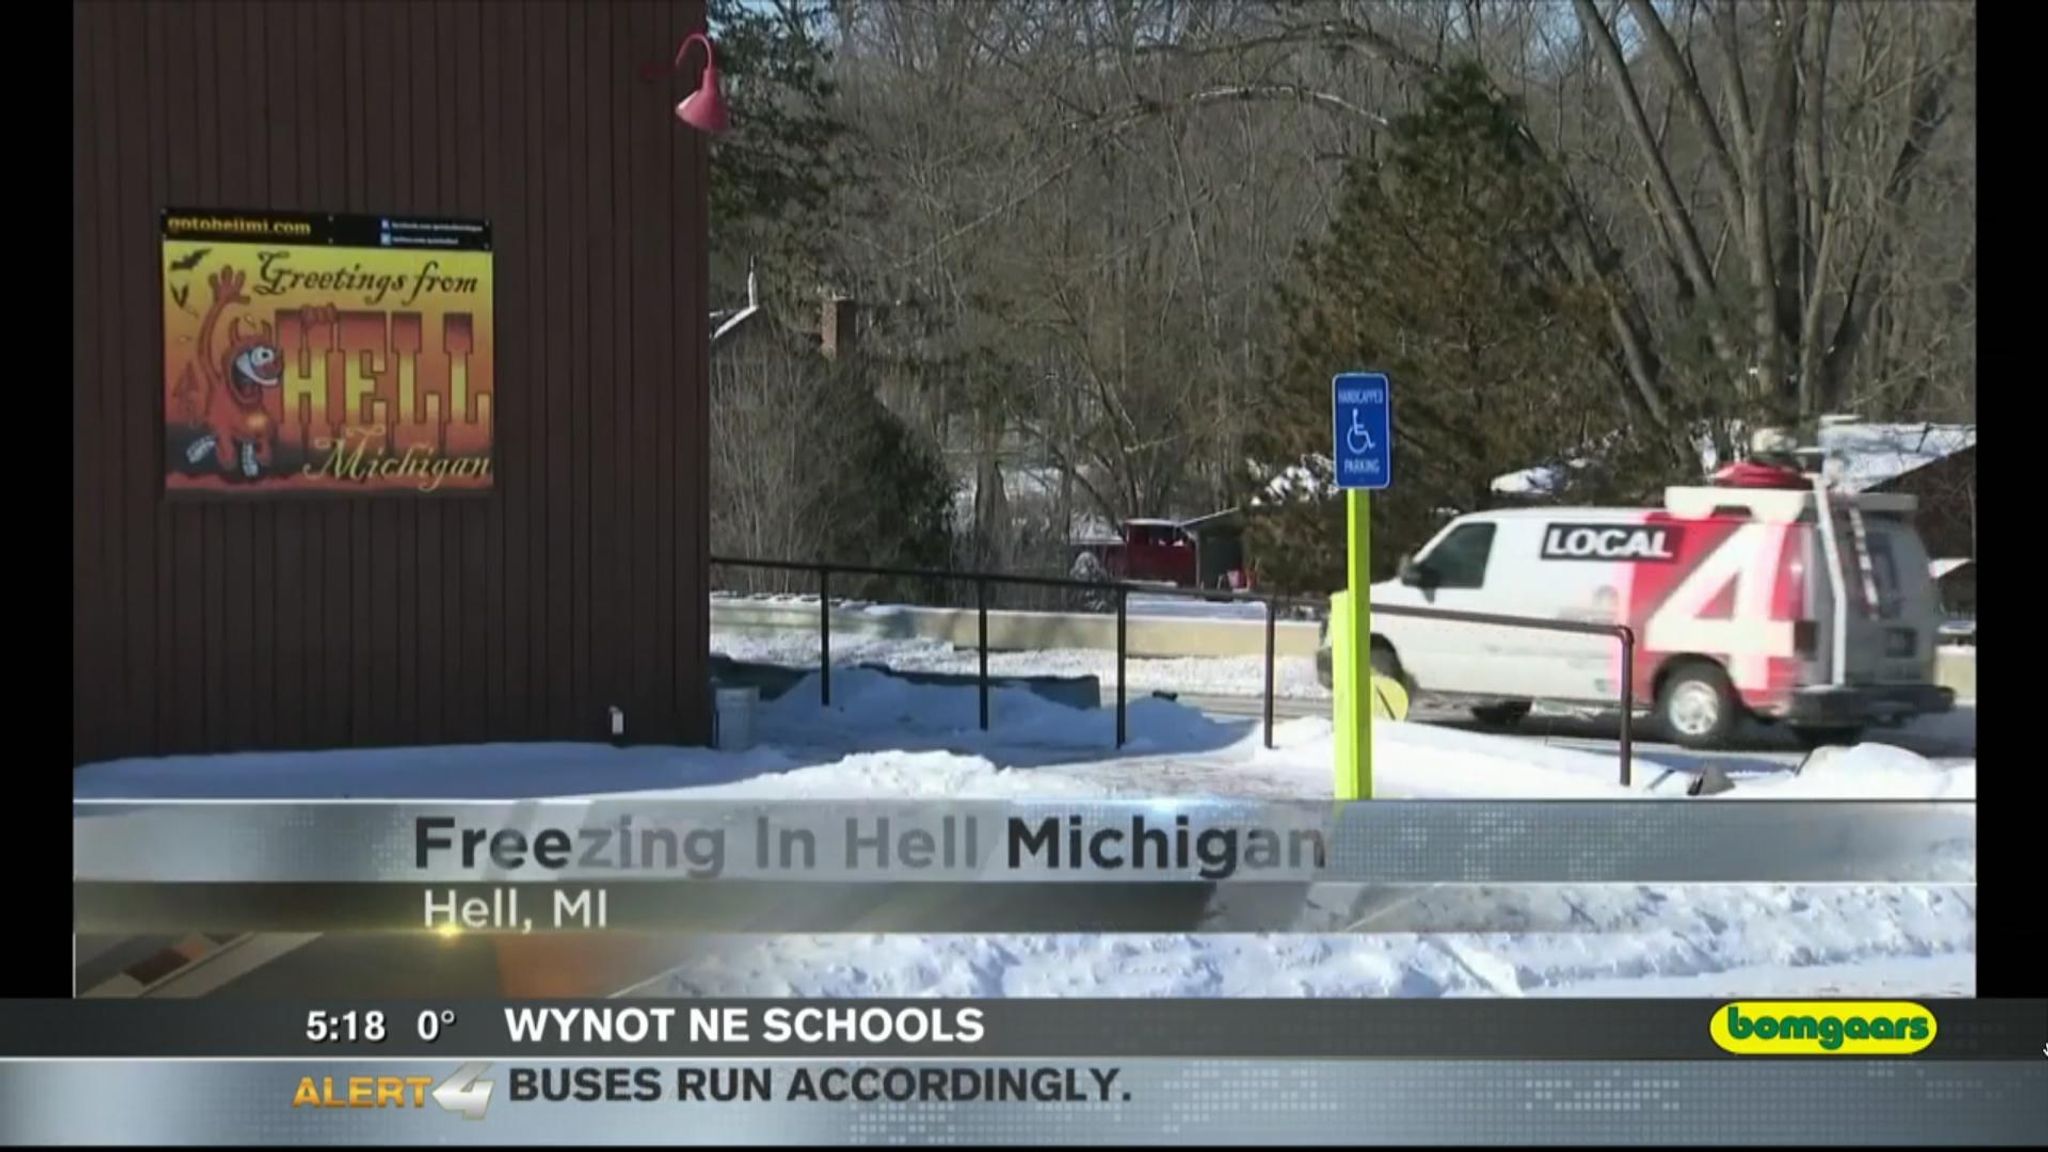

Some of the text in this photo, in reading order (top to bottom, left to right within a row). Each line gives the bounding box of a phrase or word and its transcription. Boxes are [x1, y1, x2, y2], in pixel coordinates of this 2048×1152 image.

[252, 252, 479, 306] Greetings from
[275, 309, 491, 446] HELL
[301, 424, 490, 491] Michigan
[1344, 459, 1380, 474] PARKING
[1546, 527, 1673, 557] LOCAL
[1645, 522, 1795, 689] 4
